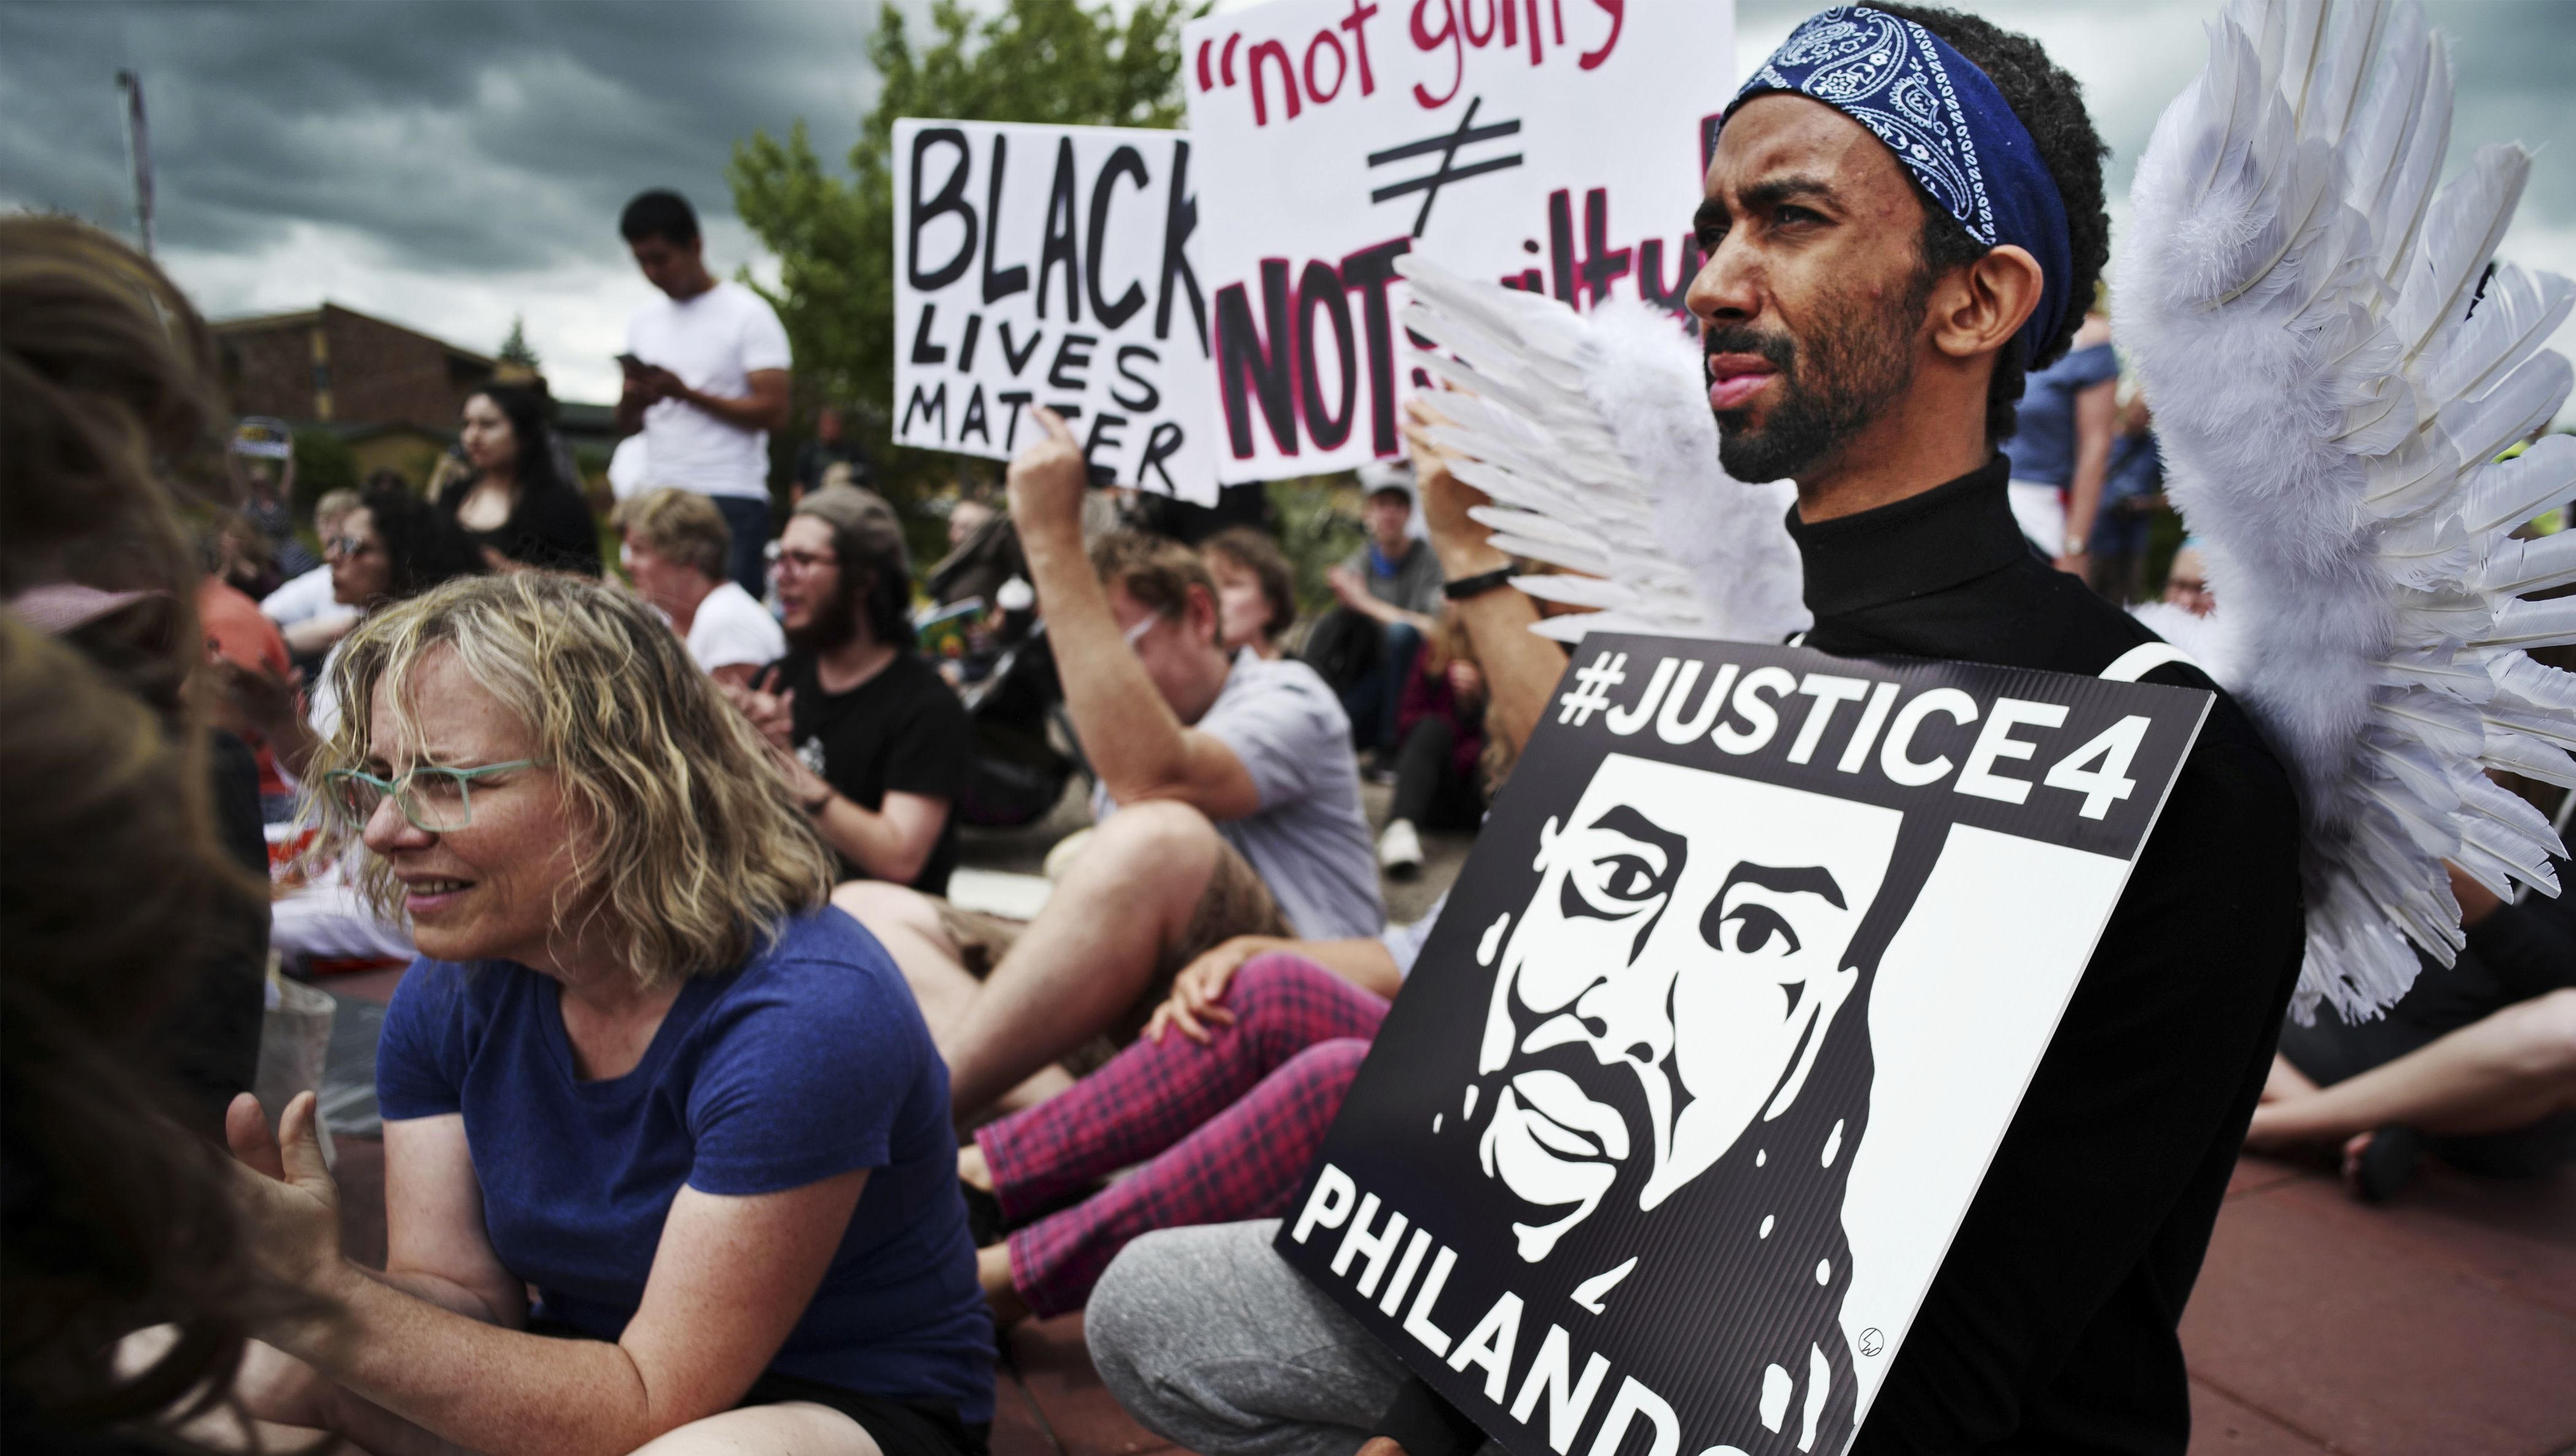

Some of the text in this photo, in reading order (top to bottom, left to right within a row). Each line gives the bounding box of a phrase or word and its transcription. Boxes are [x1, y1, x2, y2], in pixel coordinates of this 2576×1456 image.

[908, 127, 1211, 360] BLACK
[1214, 235, 1413, 460] NOT
[911, 303, 1160, 413] LIVES
[1558, 651, 2152, 821] #JUSTICE4
[1291, 1162, 1754, 1456] PHILAND
